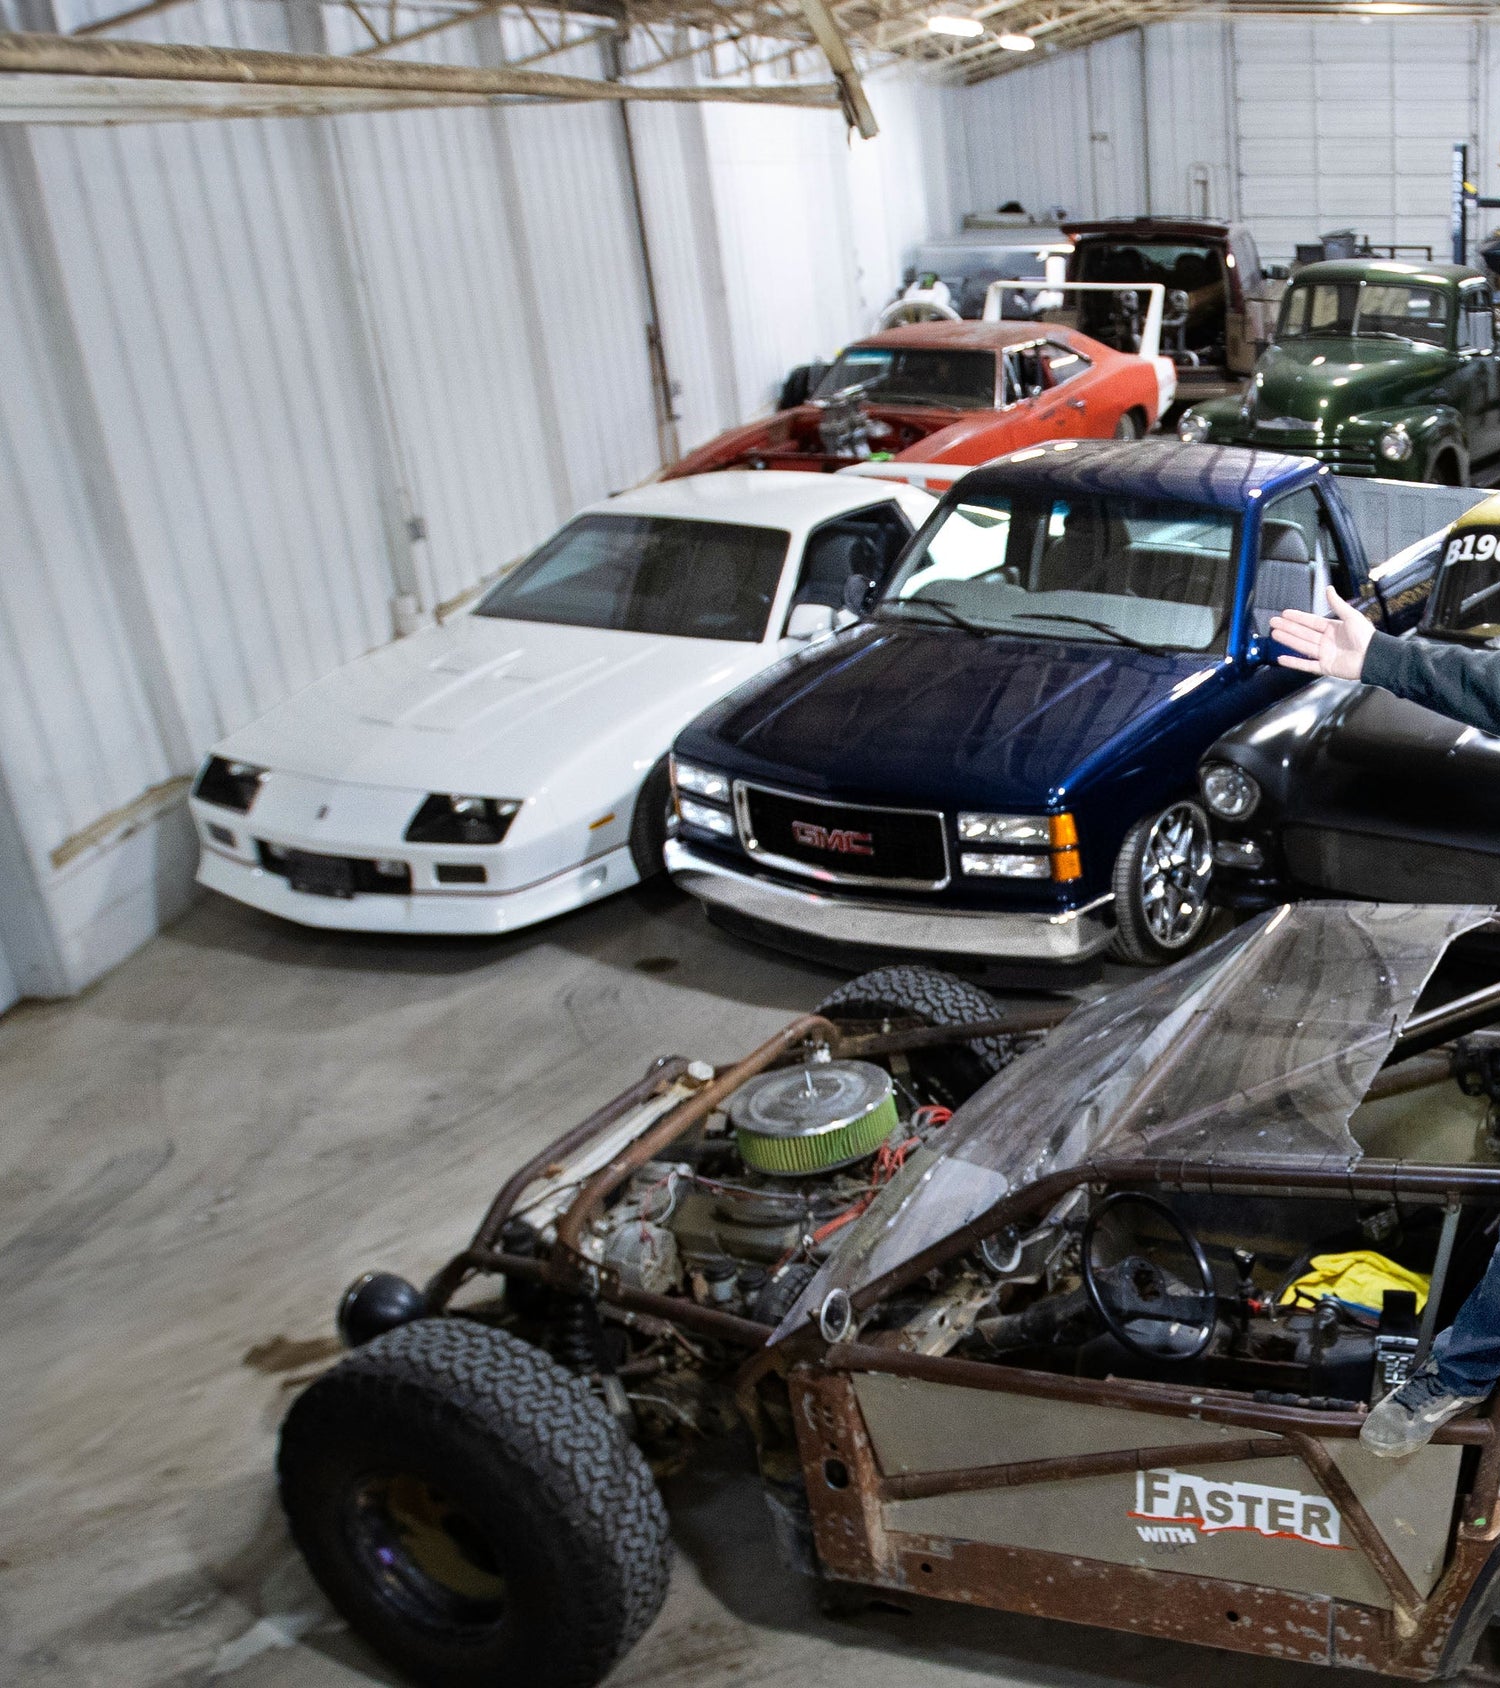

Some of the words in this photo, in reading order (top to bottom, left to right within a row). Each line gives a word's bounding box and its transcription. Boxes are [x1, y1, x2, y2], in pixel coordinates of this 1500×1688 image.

[791, 820, 874, 856] GMC
[1142, 1470, 1335, 1540] FASTER
[1136, 1525, 1198, 1544] WITH
